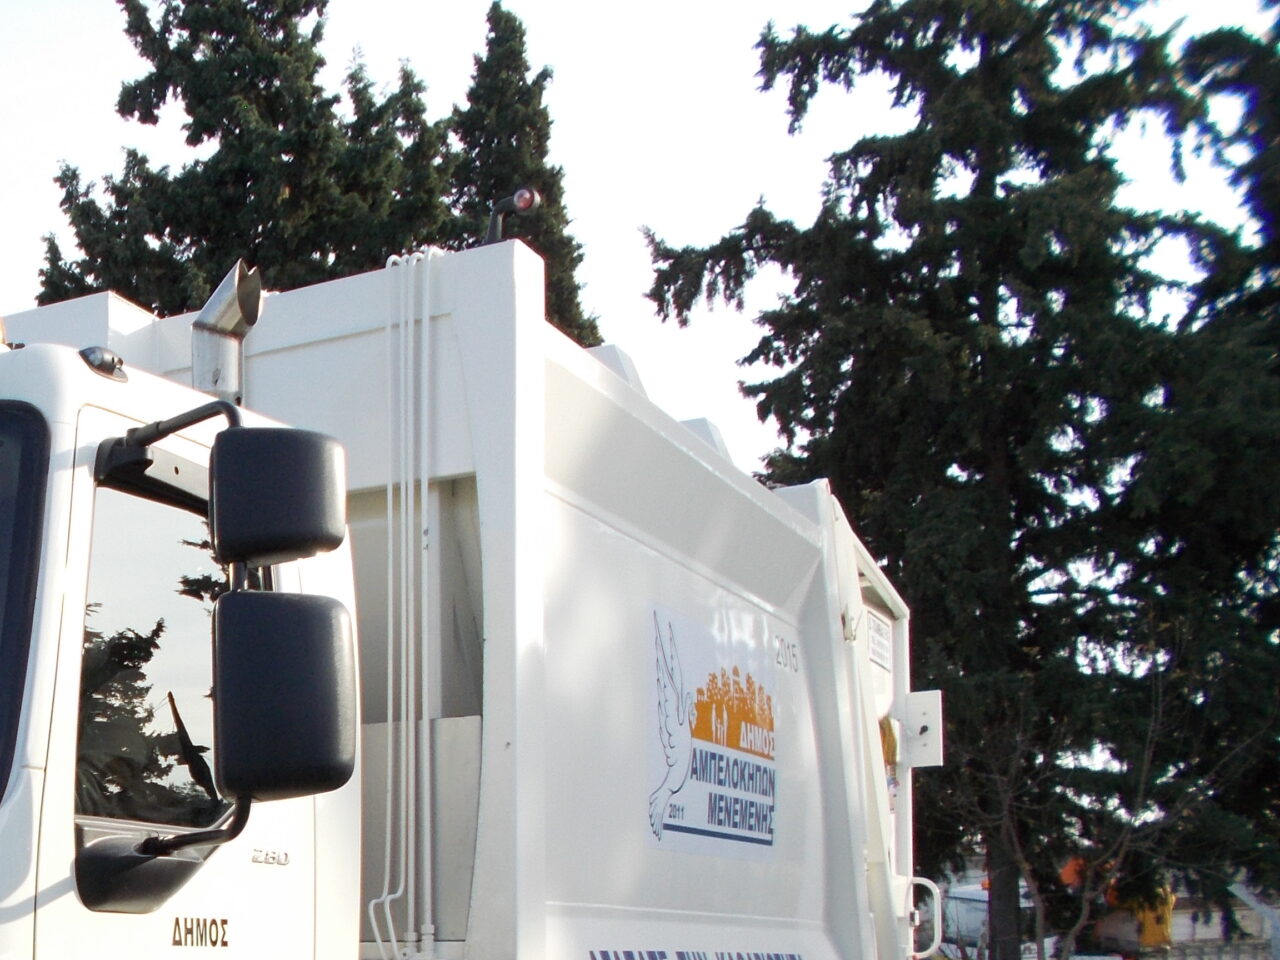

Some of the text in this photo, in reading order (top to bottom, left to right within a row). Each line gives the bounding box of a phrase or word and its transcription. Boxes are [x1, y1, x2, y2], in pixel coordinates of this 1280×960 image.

[775, 635, 798, 673] 2015
[740, 720, 775, 755] ΔΗΜΟΣ
[690, 748, 776, 797] ΑΜΠΕΛΟΚΗΠΩΝ
[668, 803, 684, 820] 2011
[707, 792, 774, 835] ΜΕΝΕΜΕΝΗΣ
[172, 917, 229, 947] ΔΗΜΟΣ
